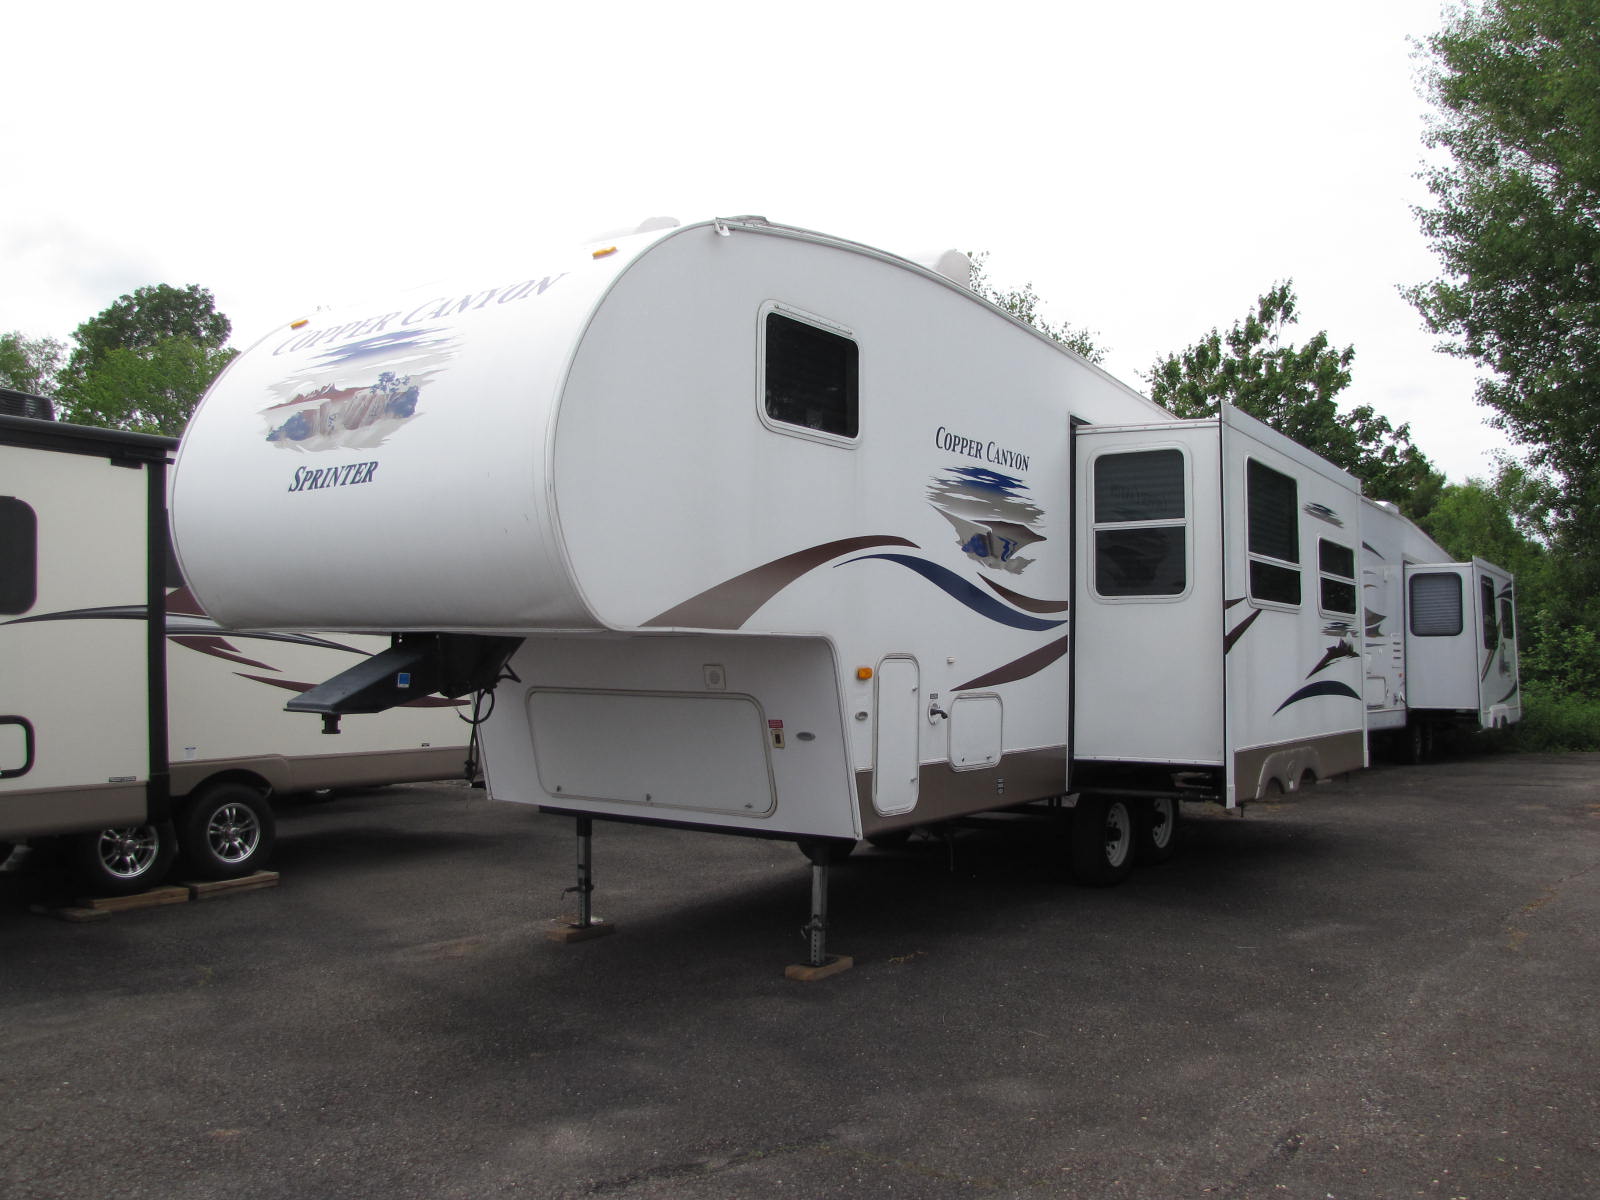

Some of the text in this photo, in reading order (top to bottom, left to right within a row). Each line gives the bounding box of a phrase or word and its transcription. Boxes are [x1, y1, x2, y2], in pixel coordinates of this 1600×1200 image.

[272, 271, 571, 356] COPPER CANYON
[935, 426, 1030, 472] COPPER CANYON
[288, 461, 379, 493] SPRINTER
